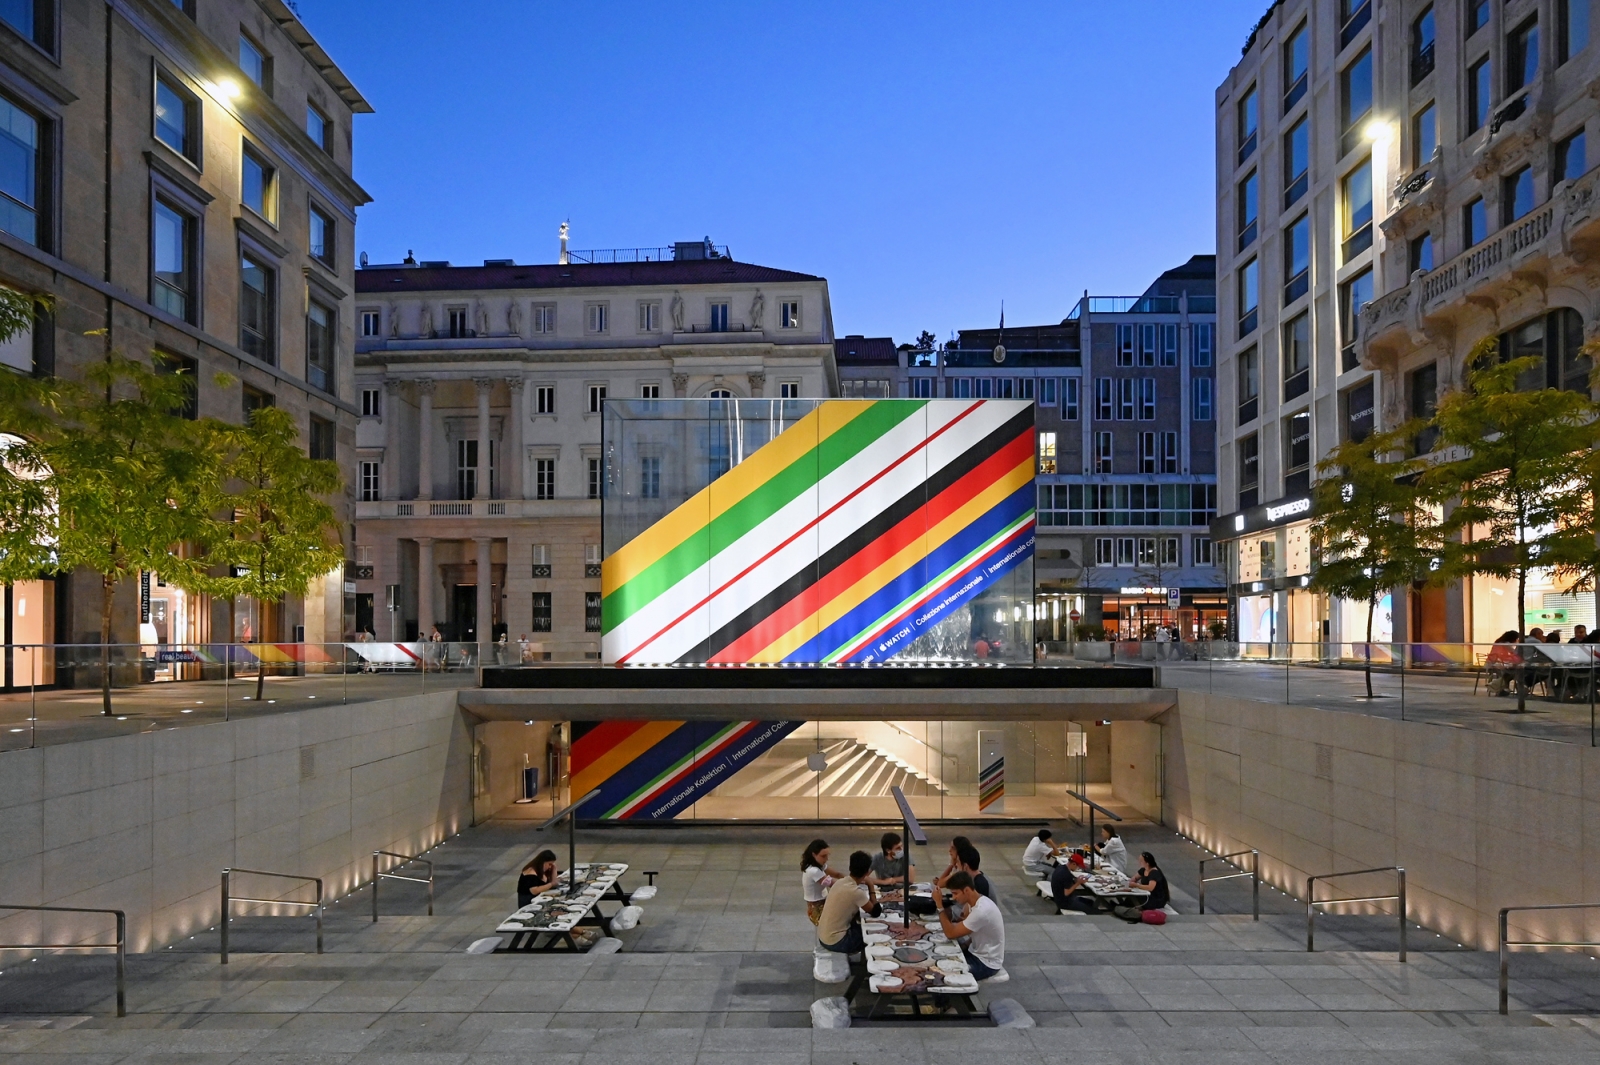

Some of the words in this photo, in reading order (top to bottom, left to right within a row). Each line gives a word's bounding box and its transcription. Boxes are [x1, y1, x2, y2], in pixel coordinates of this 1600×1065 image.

[1266, 498, 1310, 521] NESPRESSO
[884, 626, 911, 648] WATCH
[915, 602, 946, 625] Collezione
[944, 576, 983, 606] Internazionale
[988, 544, 1027, 573] Internationale
[1170, 590, 1178, 598] P
[651, 785, 695, 818] Internationale
[694, 763, 727, 788] Kollektion
[732, 728, 773, 760] International
